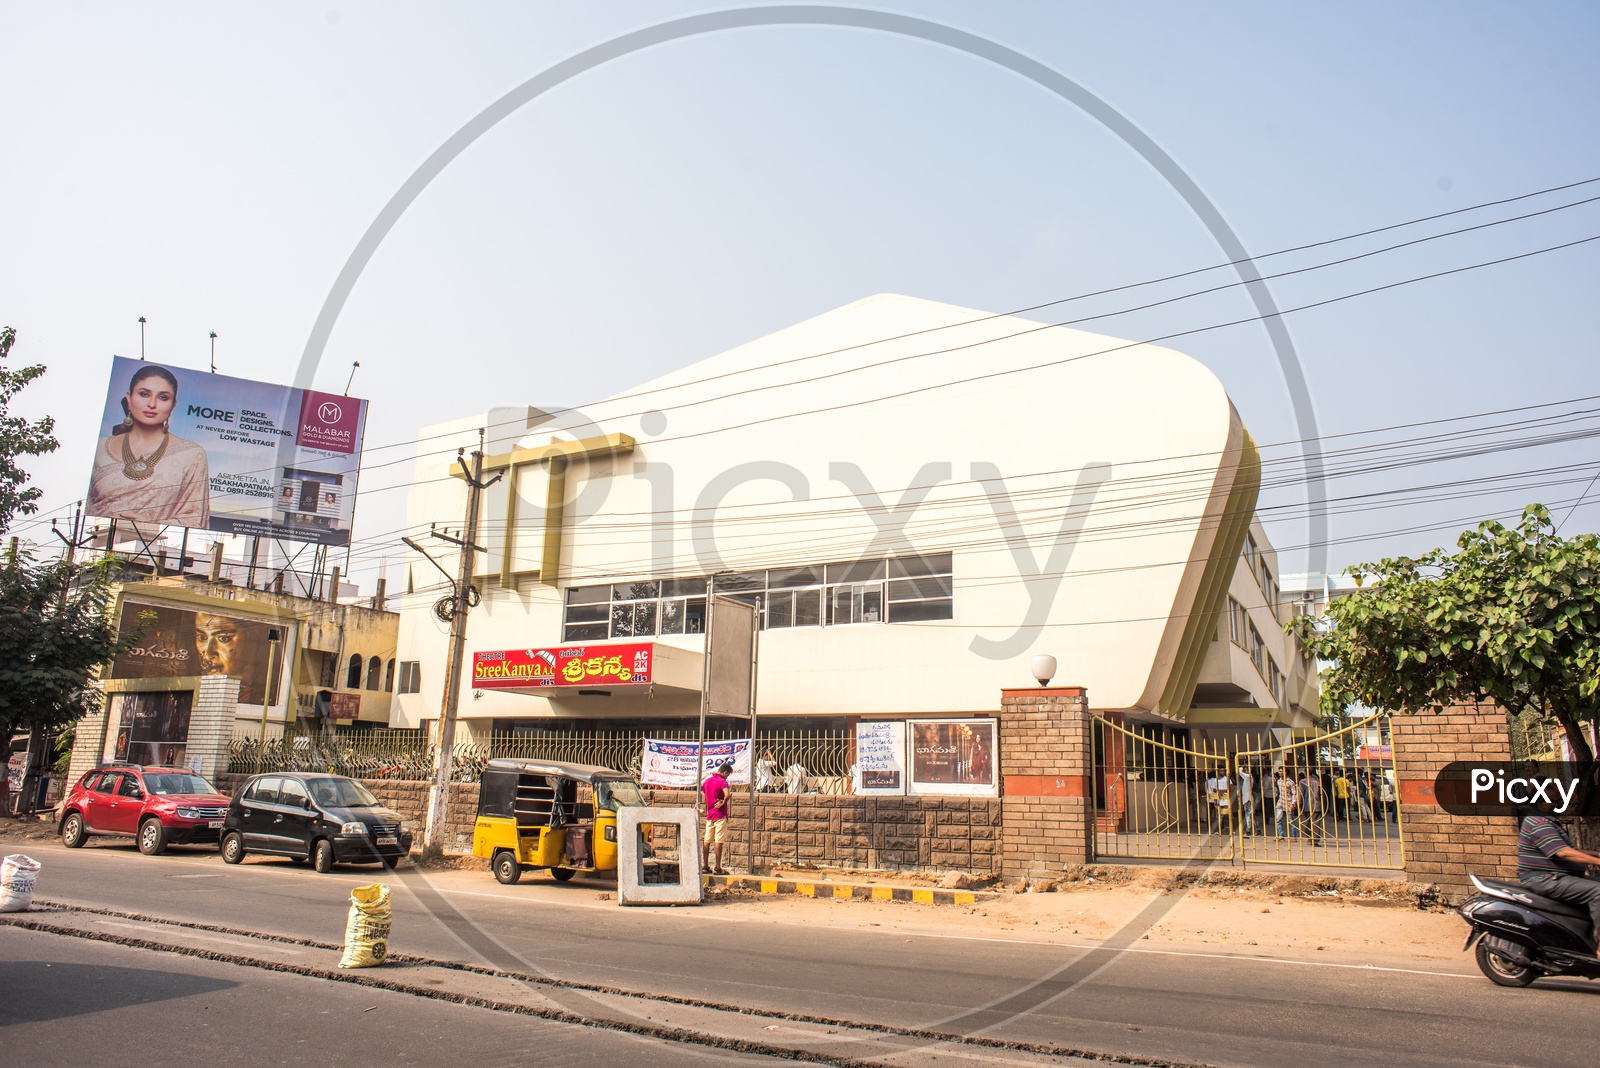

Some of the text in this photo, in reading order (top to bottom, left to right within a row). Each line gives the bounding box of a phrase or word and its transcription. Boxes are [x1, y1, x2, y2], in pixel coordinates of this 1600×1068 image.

[187, 404, 235, 423] MORE
[241, 409, 267, 419] SPACE.
[240, 416, 275, 428] DESIGNS.
[226, 429, 250, 437] BEFORE
[239, 423, 293, 437] COLLECTIONS.
[303, 424, 351, 438] MALABAR
[220, 434, 276, 448] LOW WASTAGE
[303, 431, 318, 439] GOLD
[322, 434, 350, 443] DIAMONDS
[216, 472, 258, 484] ASILMETTA
[210, 484, 225, 492] TEL:
[226, 487, 244, 495] 0891
[478, 652, 505, 661] THEATRE
[634, 651, 648, 660] AC
[635, 661, 647, 669] 2K
[475, 660, 541, 682] SreeKanya
[540, 678, 555, 686] dts
[631, 673, 647, 682] dts
